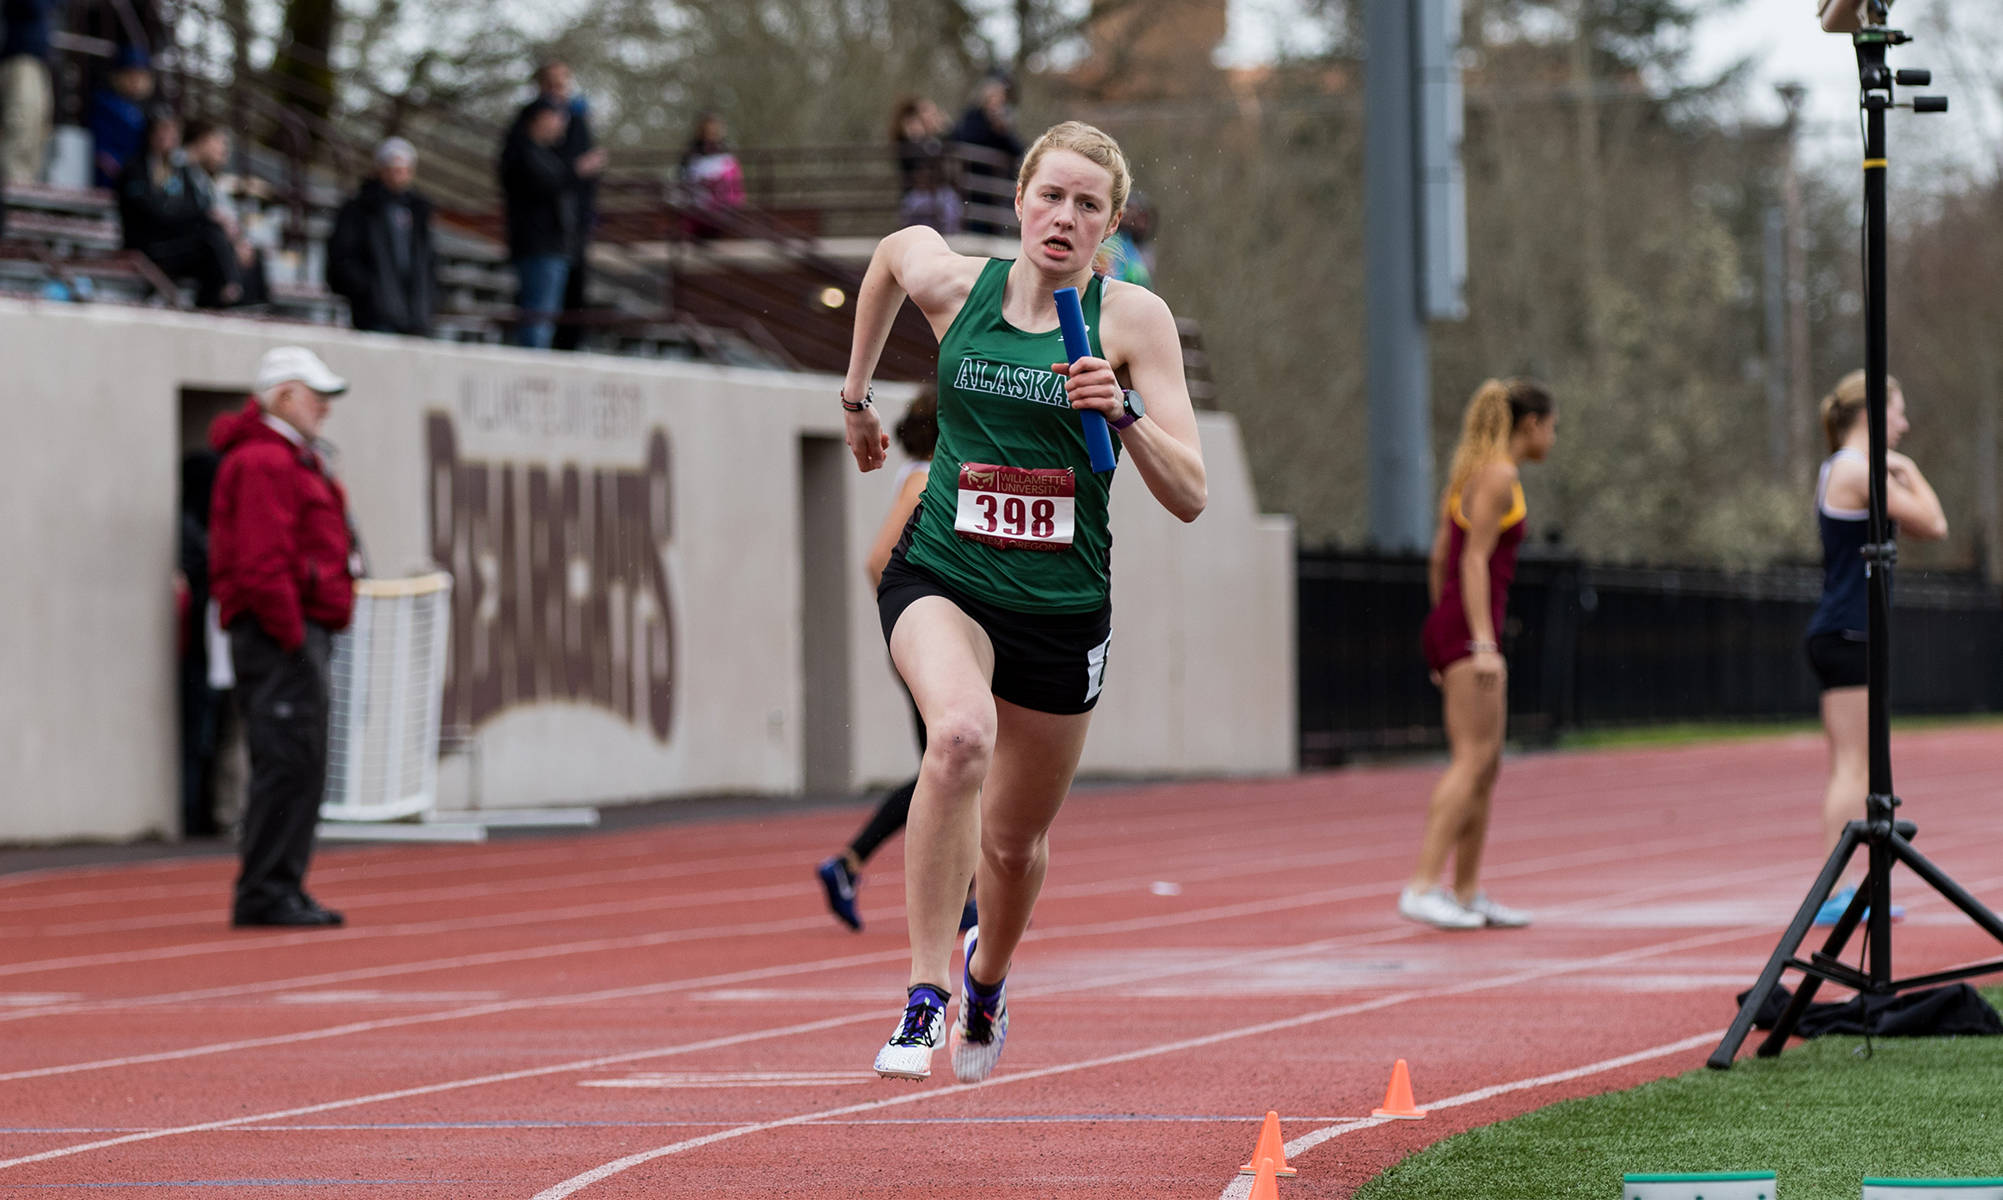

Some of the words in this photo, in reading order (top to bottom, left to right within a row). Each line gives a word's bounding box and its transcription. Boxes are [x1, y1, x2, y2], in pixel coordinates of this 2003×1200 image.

[954, 357, 1071, 408] ALASKA
[1001, 473, 1067, 485] WILLAMETTE
[1001, 482, 1060, 495] UNIVERSITY
[974, 494, 1055, 538] 398
